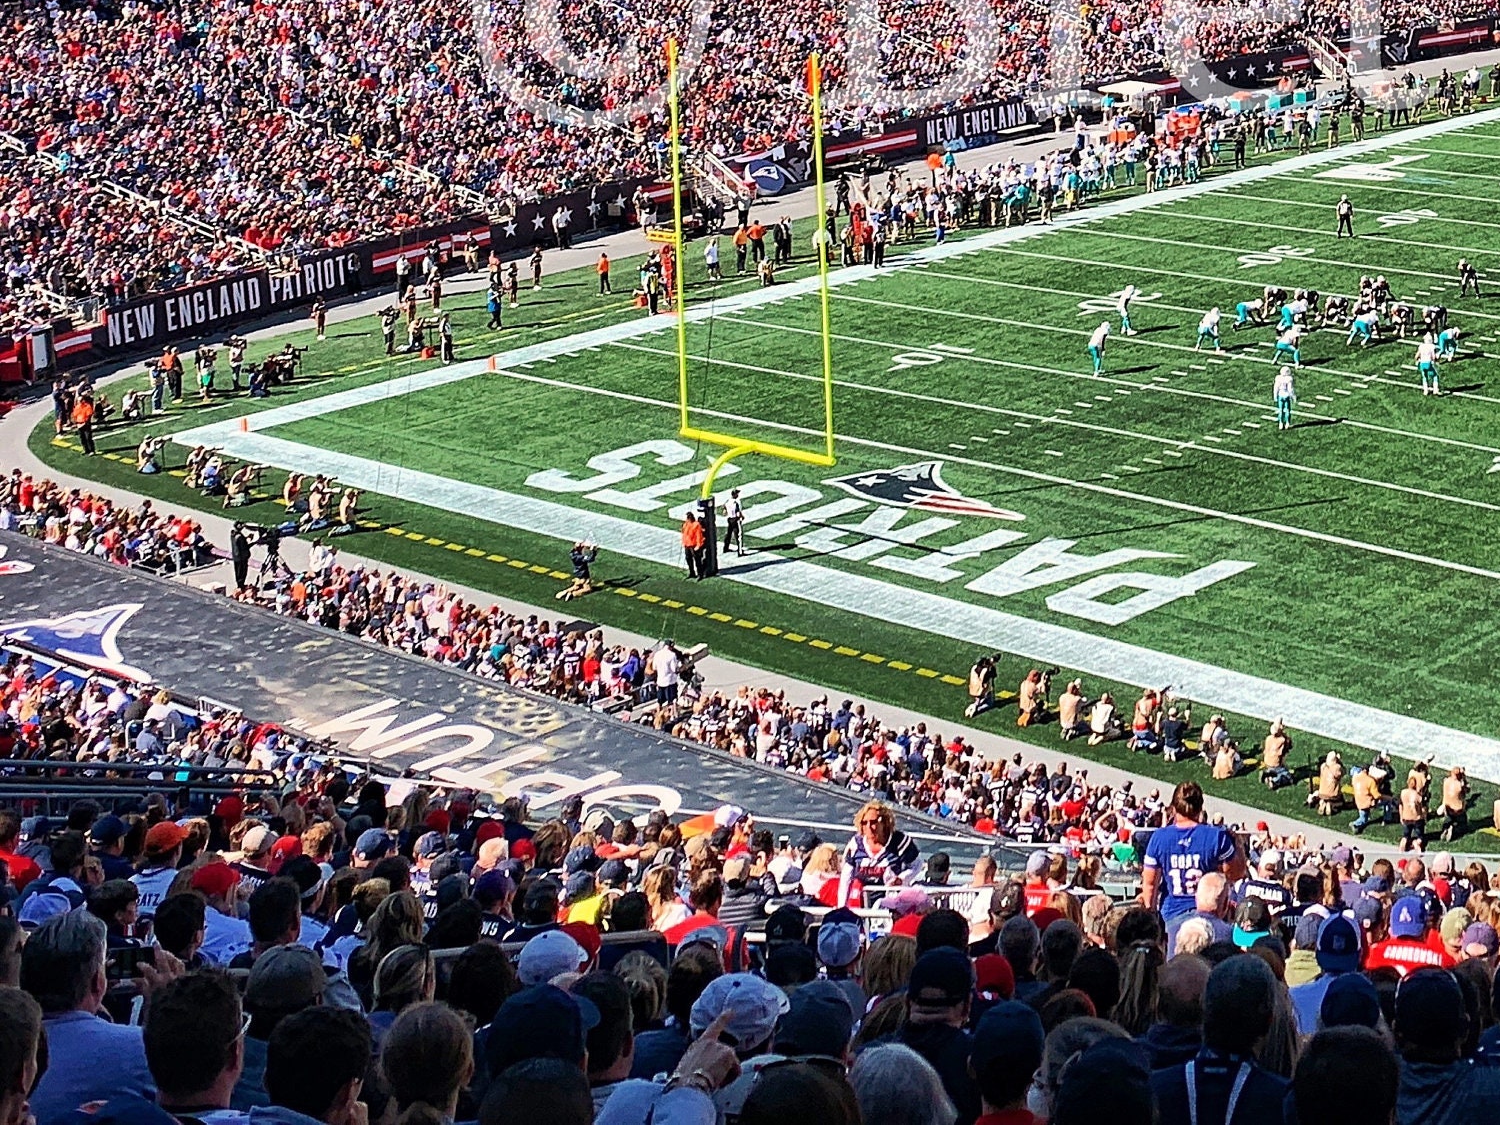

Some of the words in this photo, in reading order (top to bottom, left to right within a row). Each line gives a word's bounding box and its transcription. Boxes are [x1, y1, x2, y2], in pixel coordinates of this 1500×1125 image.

[927, 114, 958, 146] NEW
[963, 103, 1028, 137] ENGLAND
[107, 302, 156, 348] NEW
[165, 278, 261, 332] ENGLAND
[524, 438, 1258, 628] PATRIOTS
[304, 697, 683, 828] OPTUM
[1170, 853, 1201, 869] GOAT
[1383, 944, 1443, 967] GRONKOWSKI
